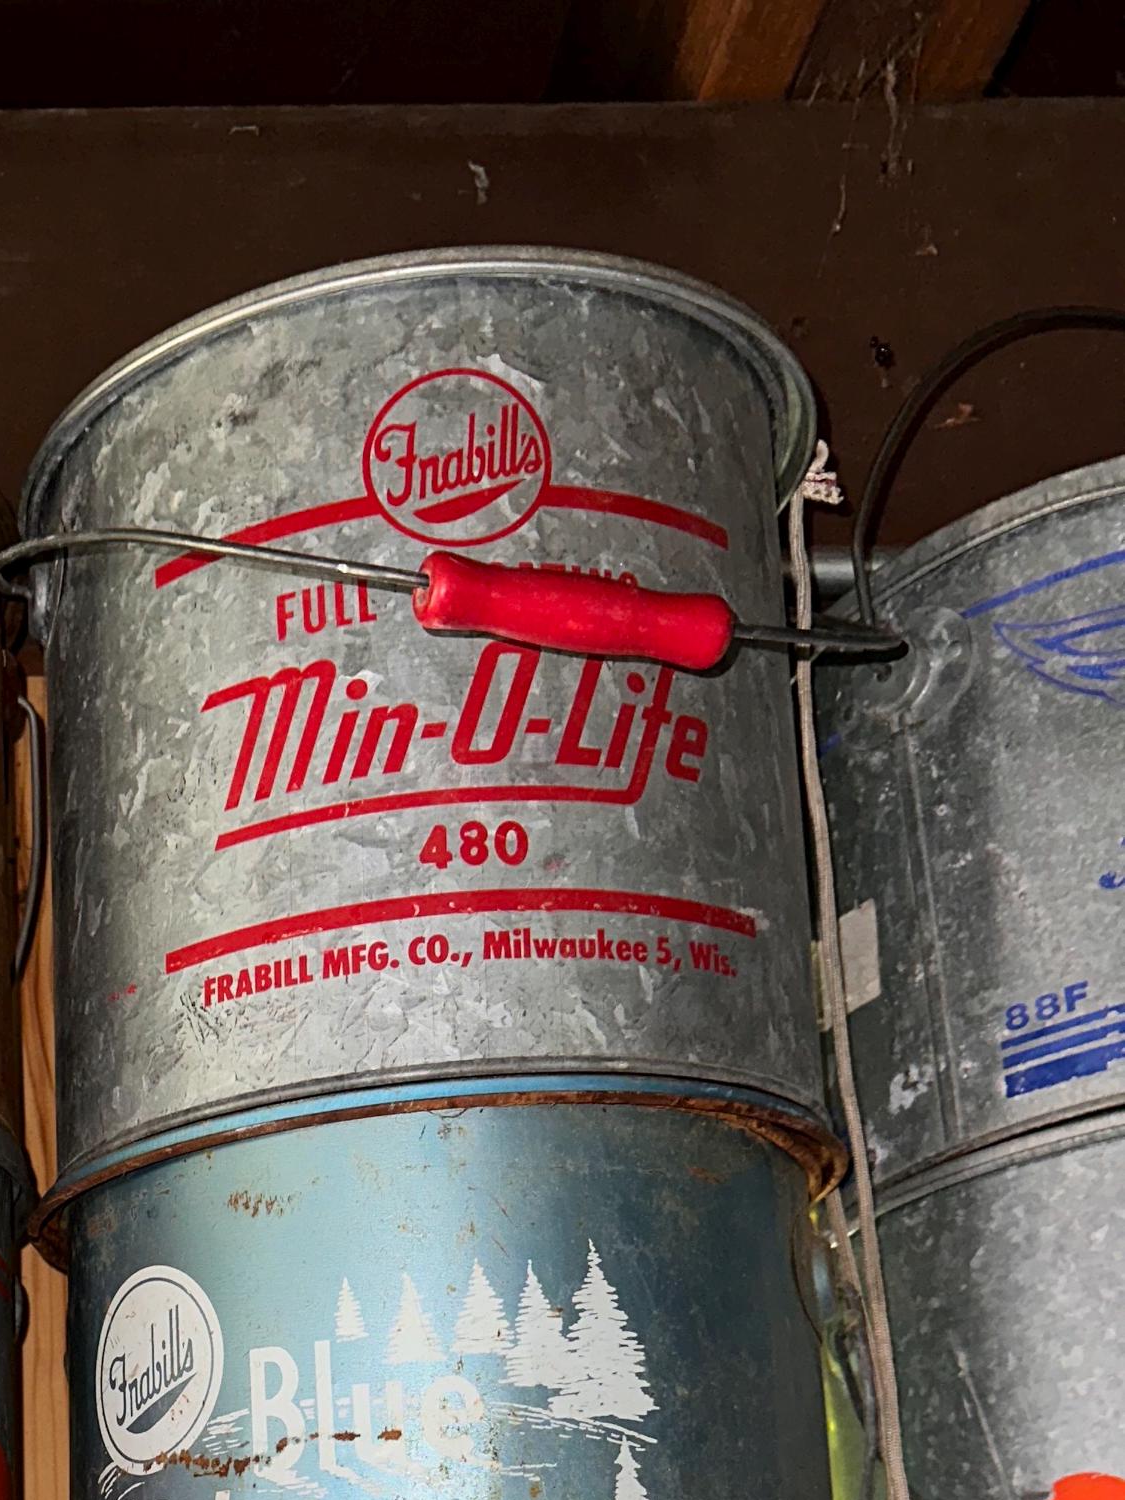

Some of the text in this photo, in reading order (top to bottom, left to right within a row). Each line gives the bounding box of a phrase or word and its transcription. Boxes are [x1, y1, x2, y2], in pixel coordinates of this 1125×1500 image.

[374, 404, 543, 507] Frabill's
[275, 578, 378, 642] FULL
[419, 821, 530, 871] 480
[202, 928, 739, 1007] FRABILL MFG. CO., Milwaukee 5, Wis.
[1005, 980, 1089, 1031] 88F
[109, 1304, 194, 1427] Frabill's
[249, 1339, 487, 1475] Blue
